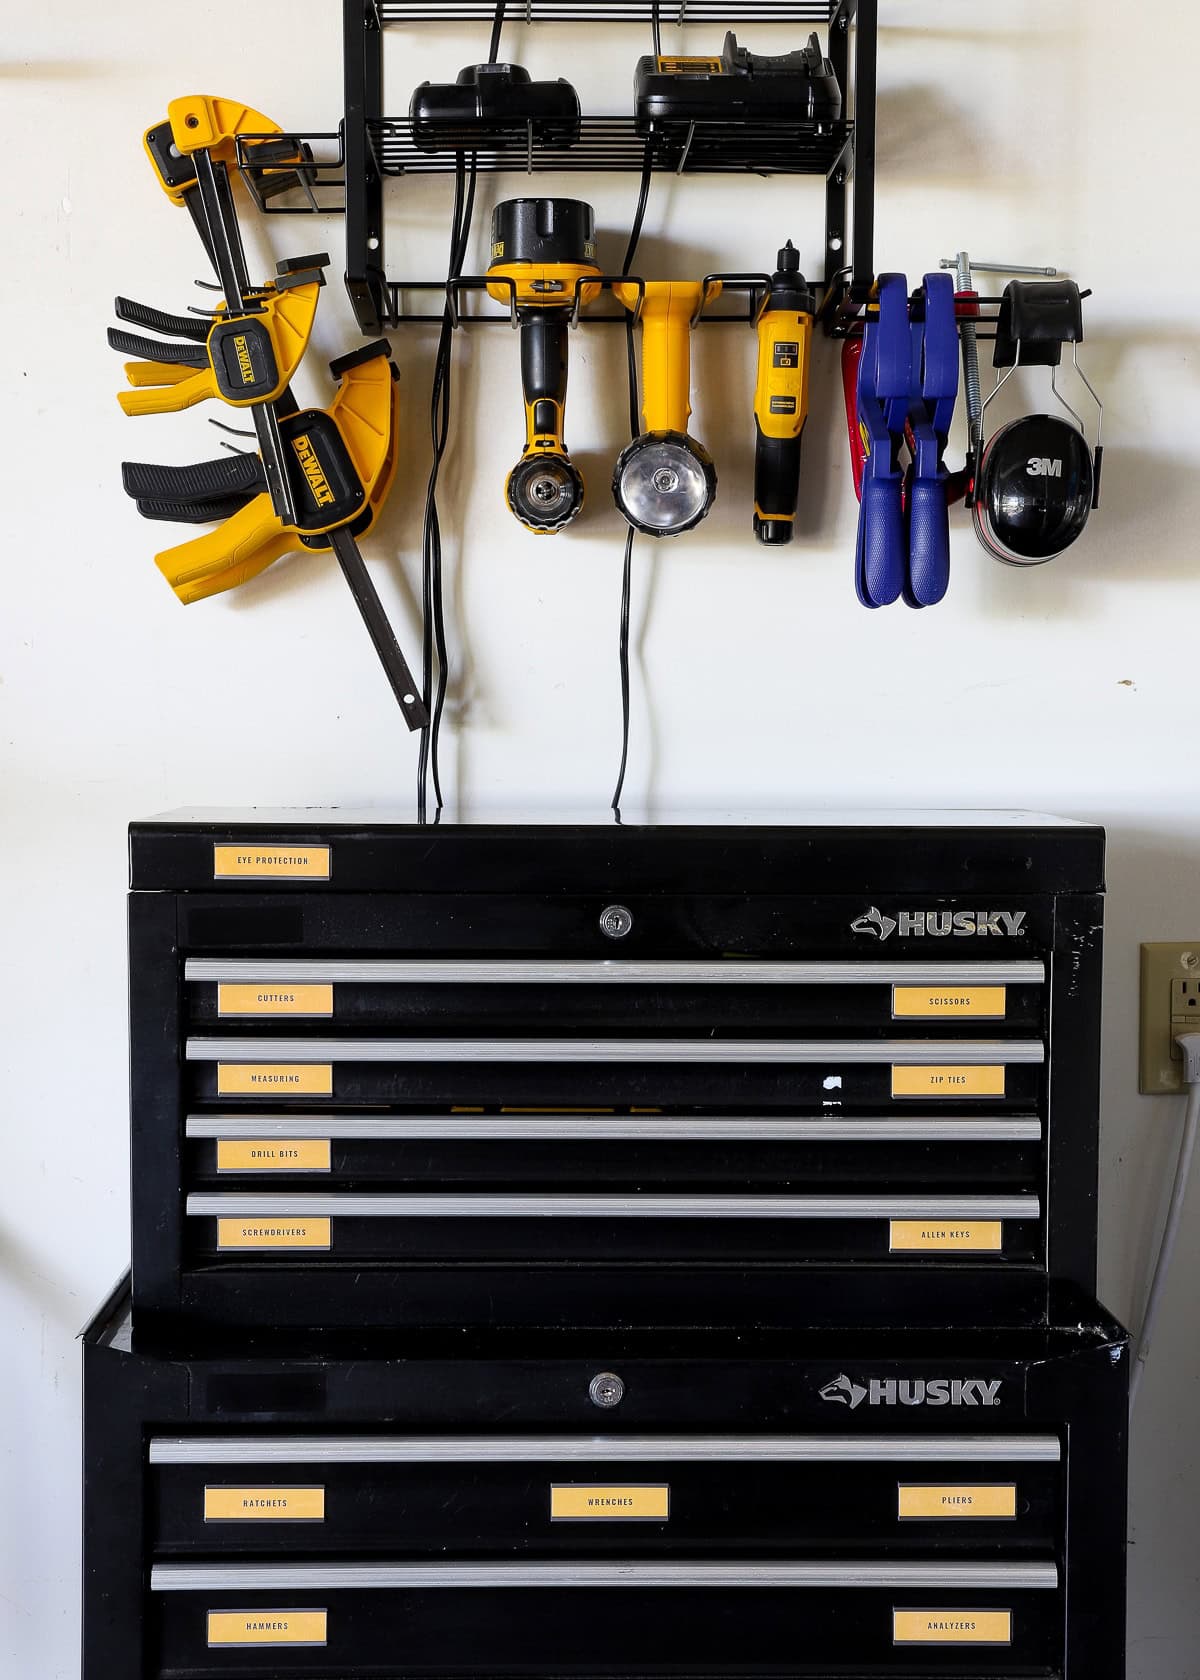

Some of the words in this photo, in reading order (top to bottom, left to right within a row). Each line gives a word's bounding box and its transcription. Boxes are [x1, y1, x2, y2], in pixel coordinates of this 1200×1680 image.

[234, 335, 255, 384] DEWALT
[291, 434, 335, 507] DEWALT
[1026, 457, 1062, 477] 3M
[237, 856, 253, 866] EYE
[255, 856, 308, 866] PROTECTION
[898, 911, 1026, 937] HUSKY
[257, 993, 295, 1003] CUTTERS
[928, 997, 971, 1006] SCISSORS
[251, 1074, 300, 1083] MEASURING
[930, 1075, 944, 1085] ZIP
[947, 1075, 966, 1085] TIES
[251, 1149, 276, 1159] DRILL
[279, 1149, 298, 1159] BITS
[242, 1228, 307, 1237] SCREWDRIVERS
[921, 1230, 946, 1239] ALLEN
[949, 1230, 970, 1239] KEYS
[869, 1379, 1002, 1406] HUSKY
[243, 1498, 288, 1508] RATCHETS
[587, 1497, 633, 1507] WRENCHES
[941, 1496, 973, 1506] PLIERS
[246, 1622, 289, 1631] HAMMERS
[927, 1621, 976, 1630] ANALYZERS
